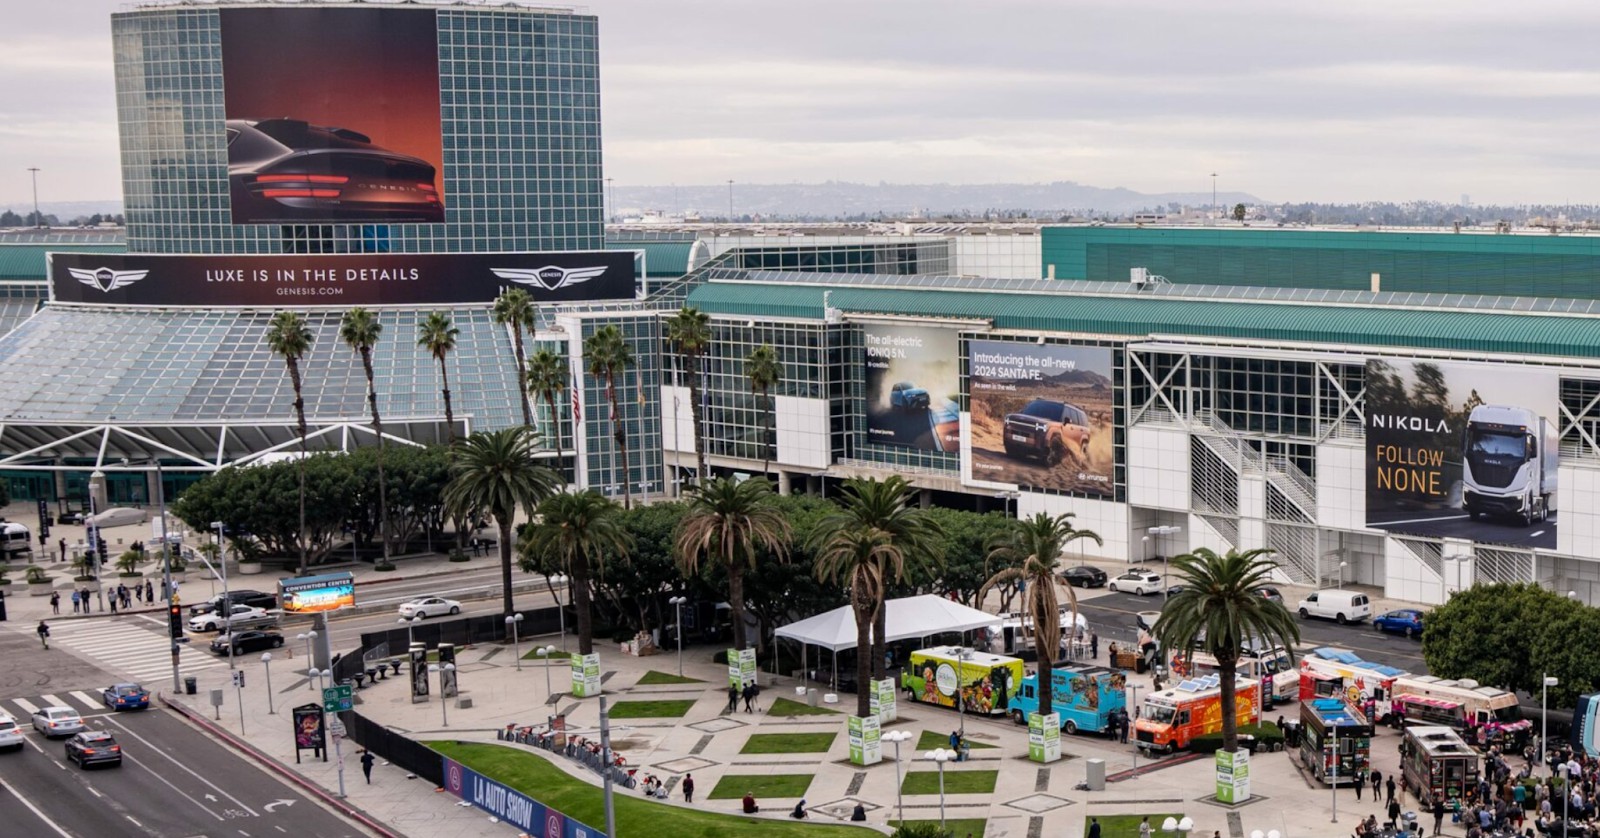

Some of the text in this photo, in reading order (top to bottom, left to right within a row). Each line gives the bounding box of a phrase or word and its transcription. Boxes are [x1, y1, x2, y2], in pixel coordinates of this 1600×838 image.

[206, 268, 419, 282] LUXE IS IN THE DETAILS
[276, 287, 344, 296] GENESIS.COM
[866, 334, 923, 347] The all-electric
[867, 347, 907, 359] IONIQ 5 N.
[974, 352, 1076, 369] Introducing the all-new
[974, 365, 1043, 381] 2024 SANTA FE.
[1372, 413, 1449, 434] NIKOLA
[1376, 444, 1444, 467] FOLLOW
[1377, 466, 1448, 496] NONE.
[285, 579, 350, 592] CONVENTION CENTER
[474, 775, 533, 830] LA AUTO SHOW
